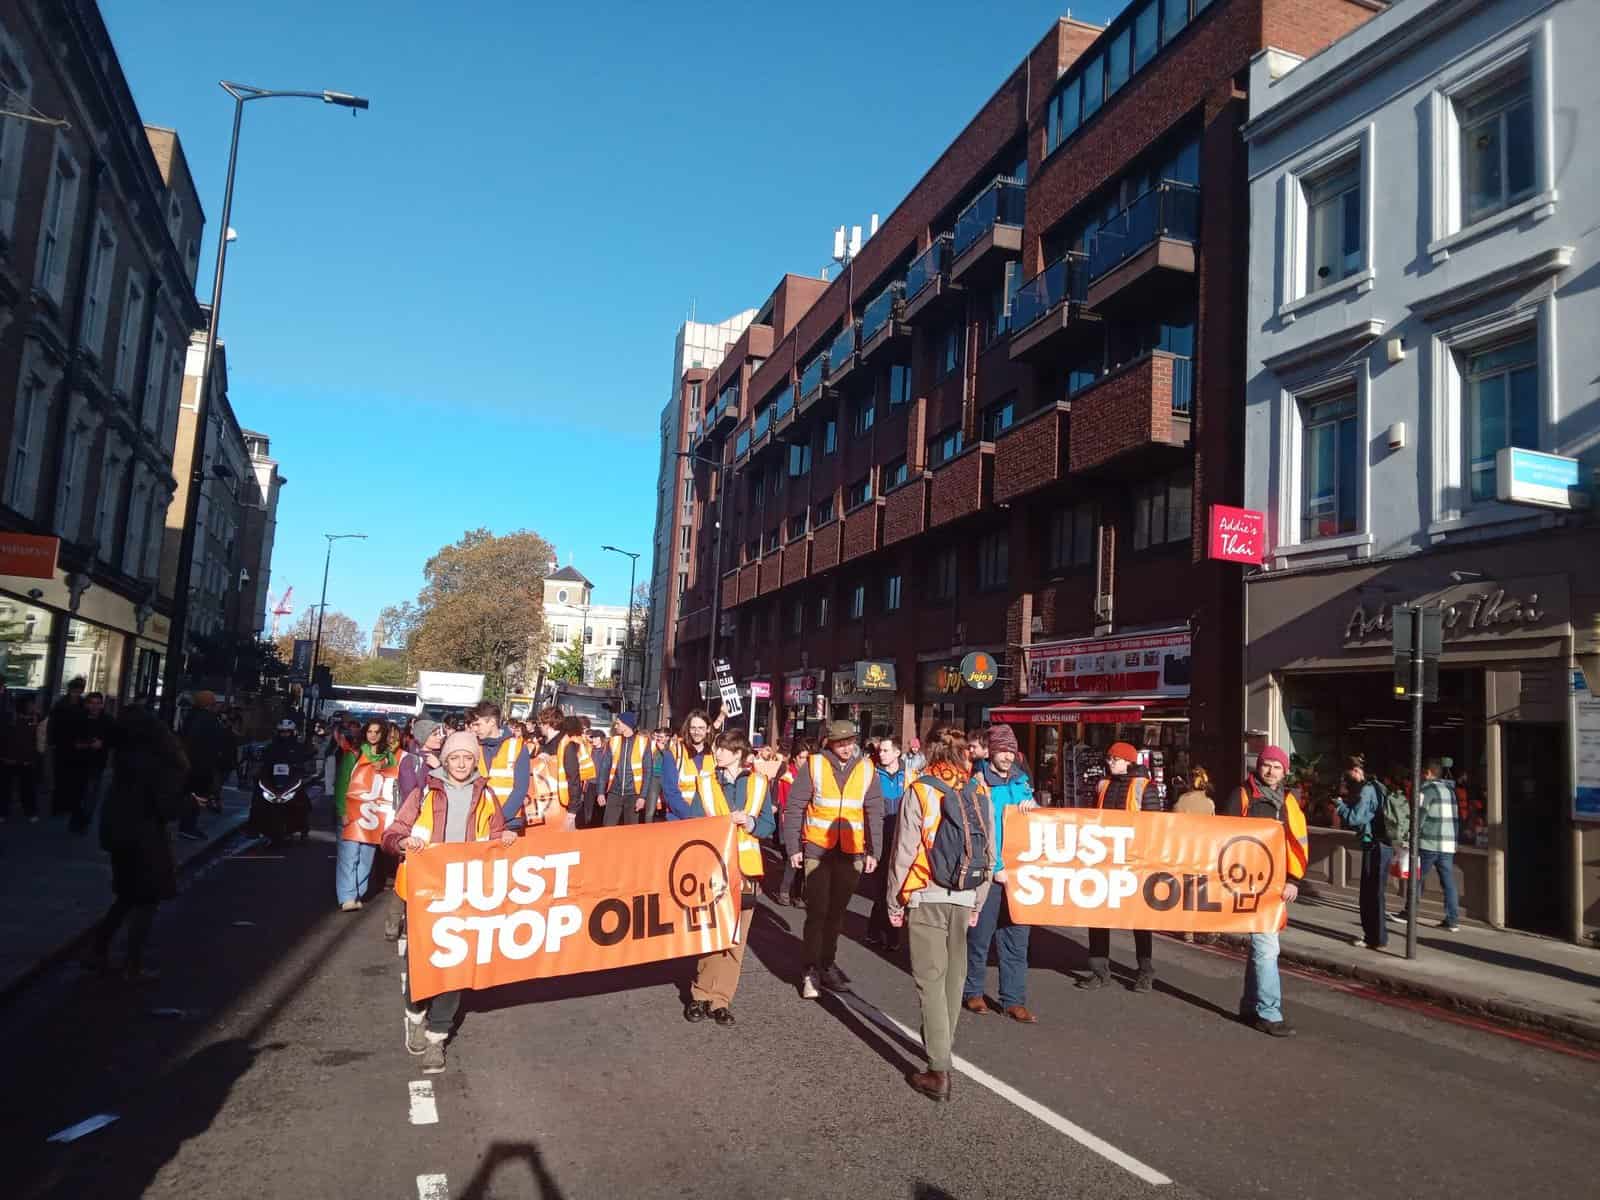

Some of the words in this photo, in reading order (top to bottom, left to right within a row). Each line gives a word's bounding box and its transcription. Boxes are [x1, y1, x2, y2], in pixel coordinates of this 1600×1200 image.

[1220, 516, 1257, 535] Addie's
[1221, 533, 1255, 556] Thai
[725, 697, 742, 714] OIL
[1016, 821, 1135, 865] JUST
[425, 851, 580, 913] JUST
[1014, 865, 1138, 908] STOP
[1143, 871, 1222, 912] OIL
[428, 904, 583, 969] STOP
[588, 893, 675, 946] OIL
